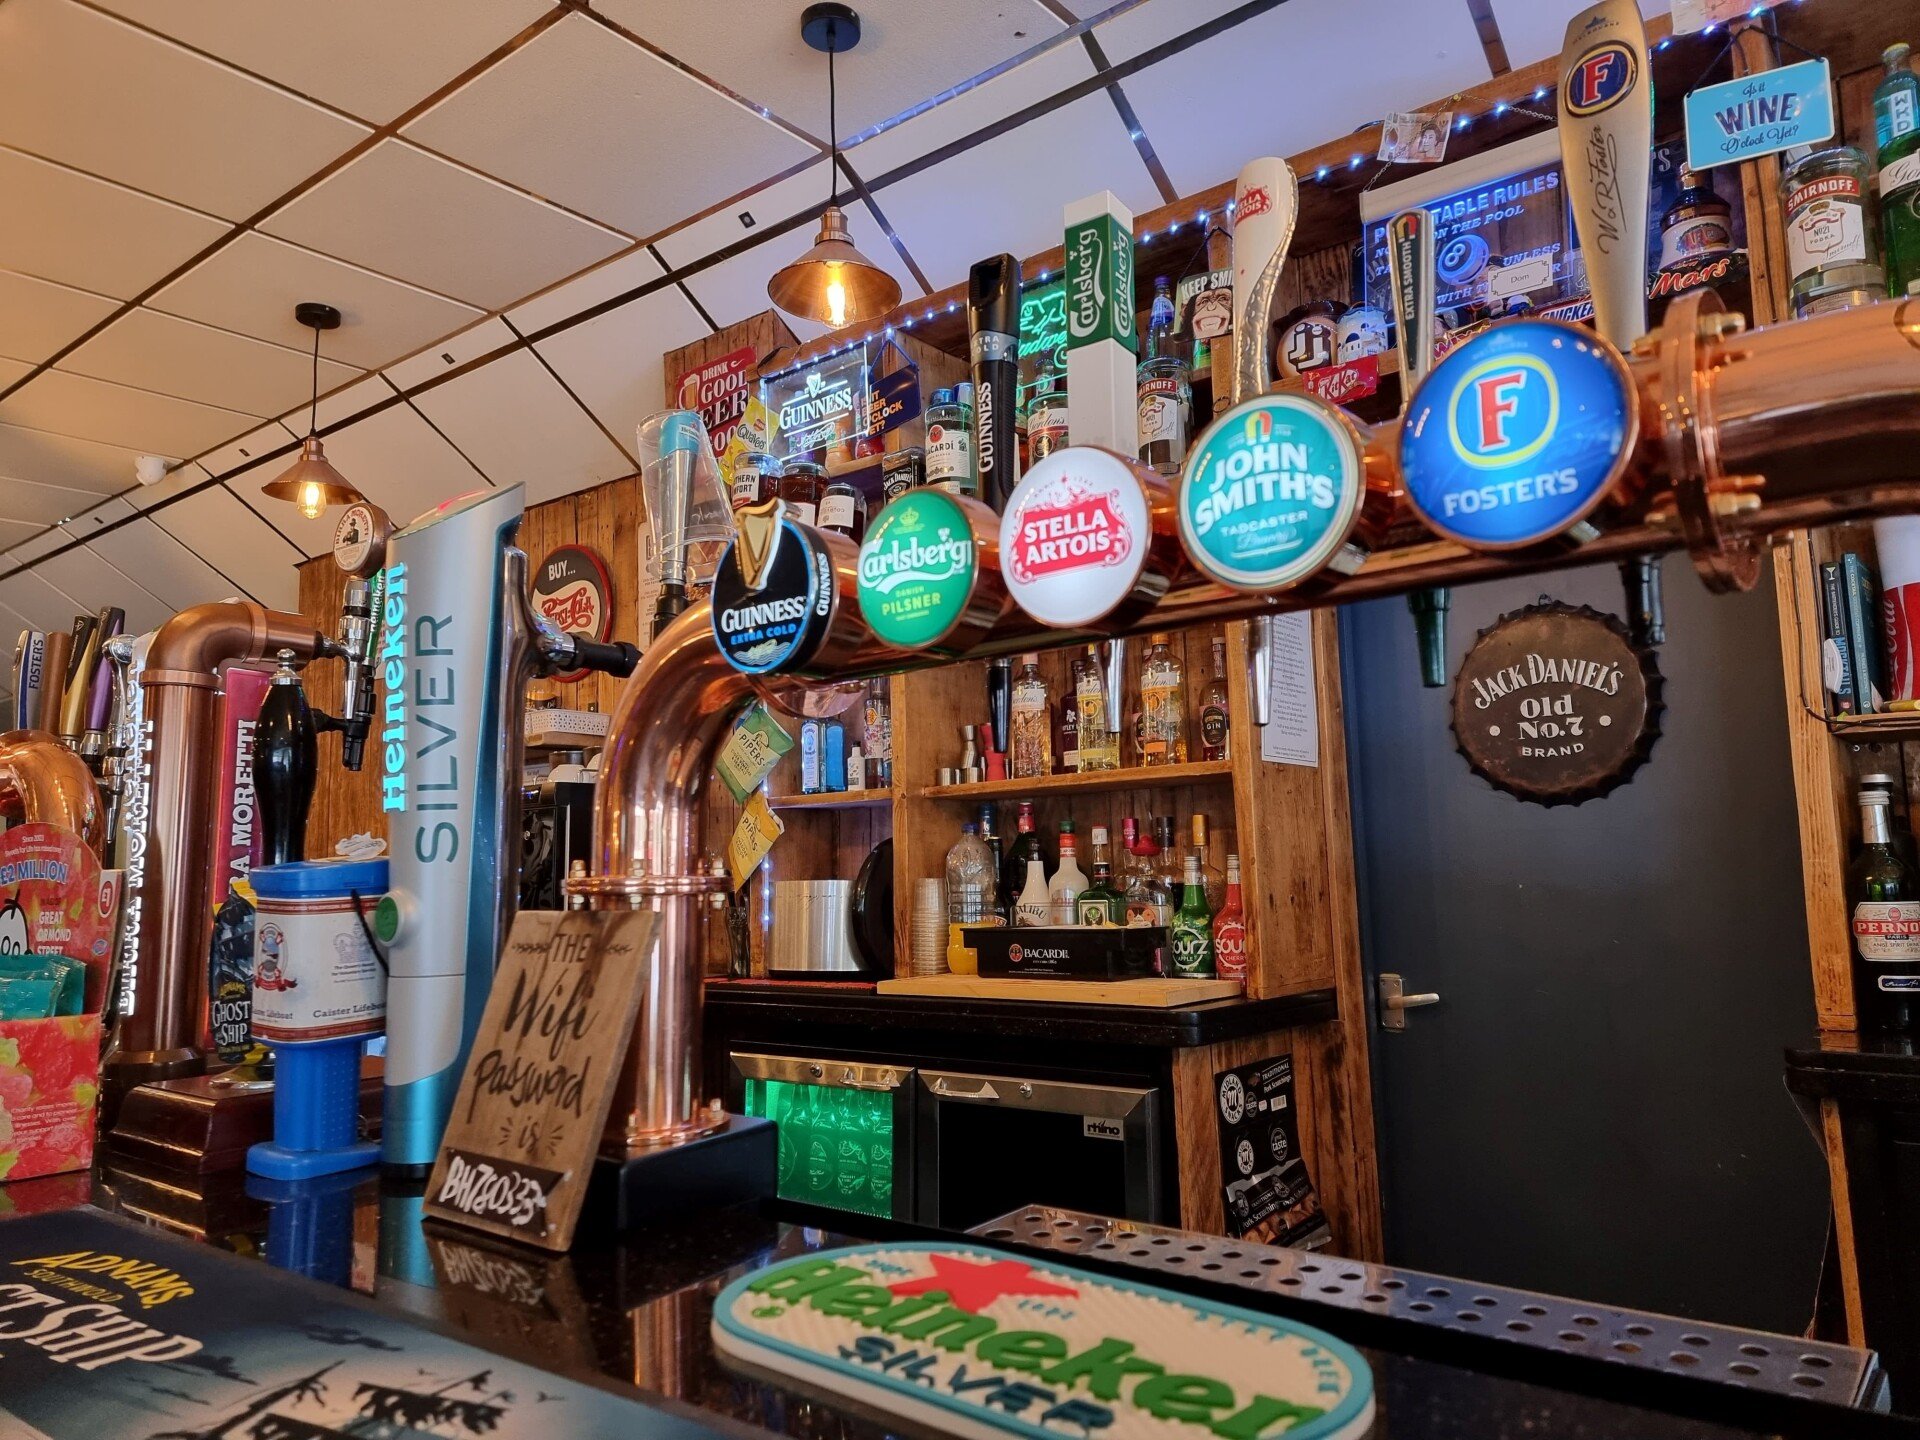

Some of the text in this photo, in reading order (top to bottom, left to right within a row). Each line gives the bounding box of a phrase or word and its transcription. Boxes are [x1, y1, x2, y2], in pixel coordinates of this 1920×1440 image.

[1582, 53, 1614, 105] F
[1715, 93, 1797, 136] WINE
[1721, 124, 1799, 154] O'clock Yet?
[1431, 171, 1559, 225] TABLE RULES
[1787, 179, 1855, 211] SMIRNOFF
[1452, 218, 1481, 236] THE
[1484, 204, 1525, 226] POOL
[1503, 242, 1561, 267] UNLESS
[1070, 228, 1101, 338] Carlsberg
[1115, 230, 1132, 338] Carlsberg
[1180, 275, 1208, 300] KEEP
[1402, 241, 1415, 321] EXTRA SMOOTH
[1437, 286, 1472, 304] WITH
[1649, 258, 1729, 300] Mars
[1541, 302, 1594, 323] SNICKER
[702, 361, 728, 382] DRINK
[1321, 370, 1357, 400] KitKat
[1139, 382, 1173, 397] MIRNOFF
[700, 389, 747, 430] EER
[779, 387, 853, 430] GUINNESS
[1475, 367, 1527, 452] F
[978, 381, 994, 473] GUINNESS
[736, 474, 756, 483] THERN
[1208, 442, 1308, 494] JOHN
[1195, 471, 1336, 537] SMITH'S
[1443, 467, 1580, 517] FOSTER'S
[1024, 508, 1109, 544] STELLA
[1220, 510, 1308, 537] TADCASTER
[859, 536, 972, 590] Carlsberg
[1026, 530, 1111, 566] ARTOIS
[816, 552, 831, 616] GUINNESS
[721, 595, 808, 633] GUINNESS
[882, 592, 941, 616] PILSNER
[730, 623, 797, 645] EXTRA COLD
[28, 639, 44, 690] FOSTER'S
[1471, 653, 1624, 709] JACK DANIEL'S
[383, 562, 409, 813] Heineken
[1520, 694, 1574, 718] Old
[415, 614, 459, 864] SILVER
[1206, 721, 1221, 731] GIN
[739, 733, 764, 767] PIPERS
[1522, 742, 1584, 757] BRAND
[231, 719, 257, 847] MORETTI
[742, 815, 758, 852] PIPERS
[17, 859, 69, 885] MILLION
[39, 911, 65, 925] GREAT
[1857, 922, 1920, 933] PERNO
[551, 933, 592, 963] THE
[1024, 948, 1065, 959] BACARDI
[212, 1000, 251, 1028] GHOST
[313, 1008, 350, 1019] Caister
[503, 968, 599, 1061] Wifi
[220, 1022, 248, 1047] SHIP
[467, 1049, 591, 1125] Password
[1261, 1061, 1290, 1081] TRADITIONAL
[517, 1116, 541, 1150] is
[1087, 1119, 1121, 1136] rhino
[1272, 1139, 1287, 1152] taste
[24, 1268, 124, 1302] SOUTHWOLD
[0, 1303, 204, 1371] SHIP
[838, 1335, 1114, 1439] SILVER
